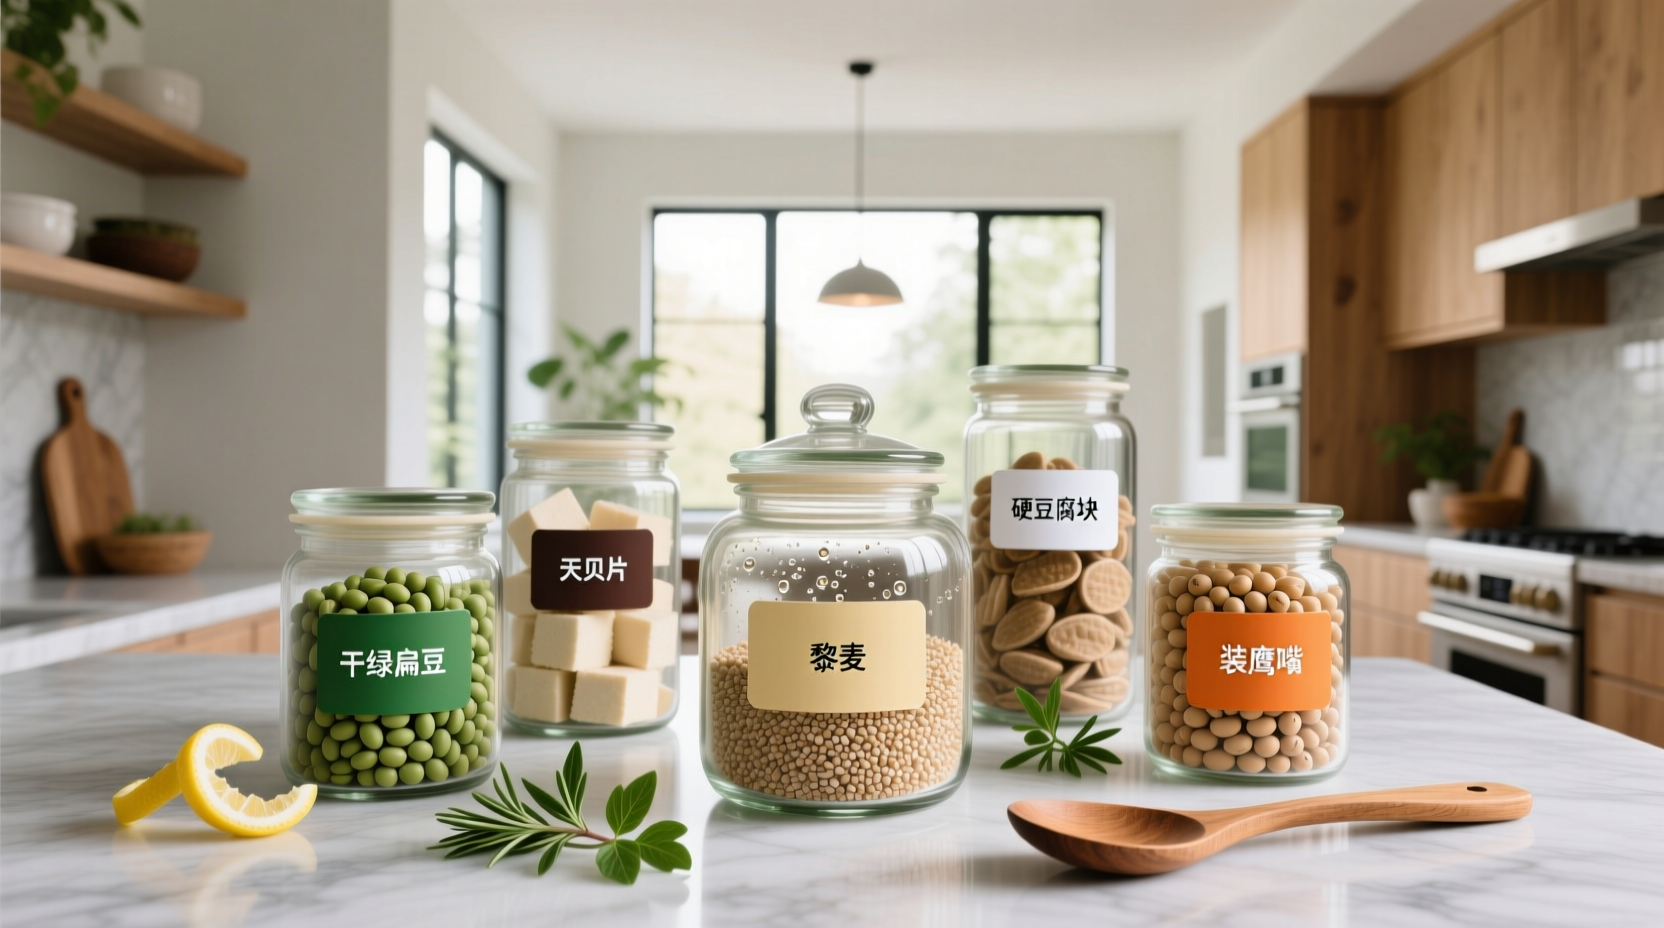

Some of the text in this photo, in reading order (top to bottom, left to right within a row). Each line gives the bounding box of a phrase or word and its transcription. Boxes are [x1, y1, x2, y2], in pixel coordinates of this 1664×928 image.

[1011, 496, 1098, 522] 硬豆腐块
[559, 555, 628, 582] 天贝片
[339, 647, 447, 678] 干绿扁豆
[809, 641, 867, 673] 黎麦
[1219, 644, 1304, 676] 装鹰嘴
